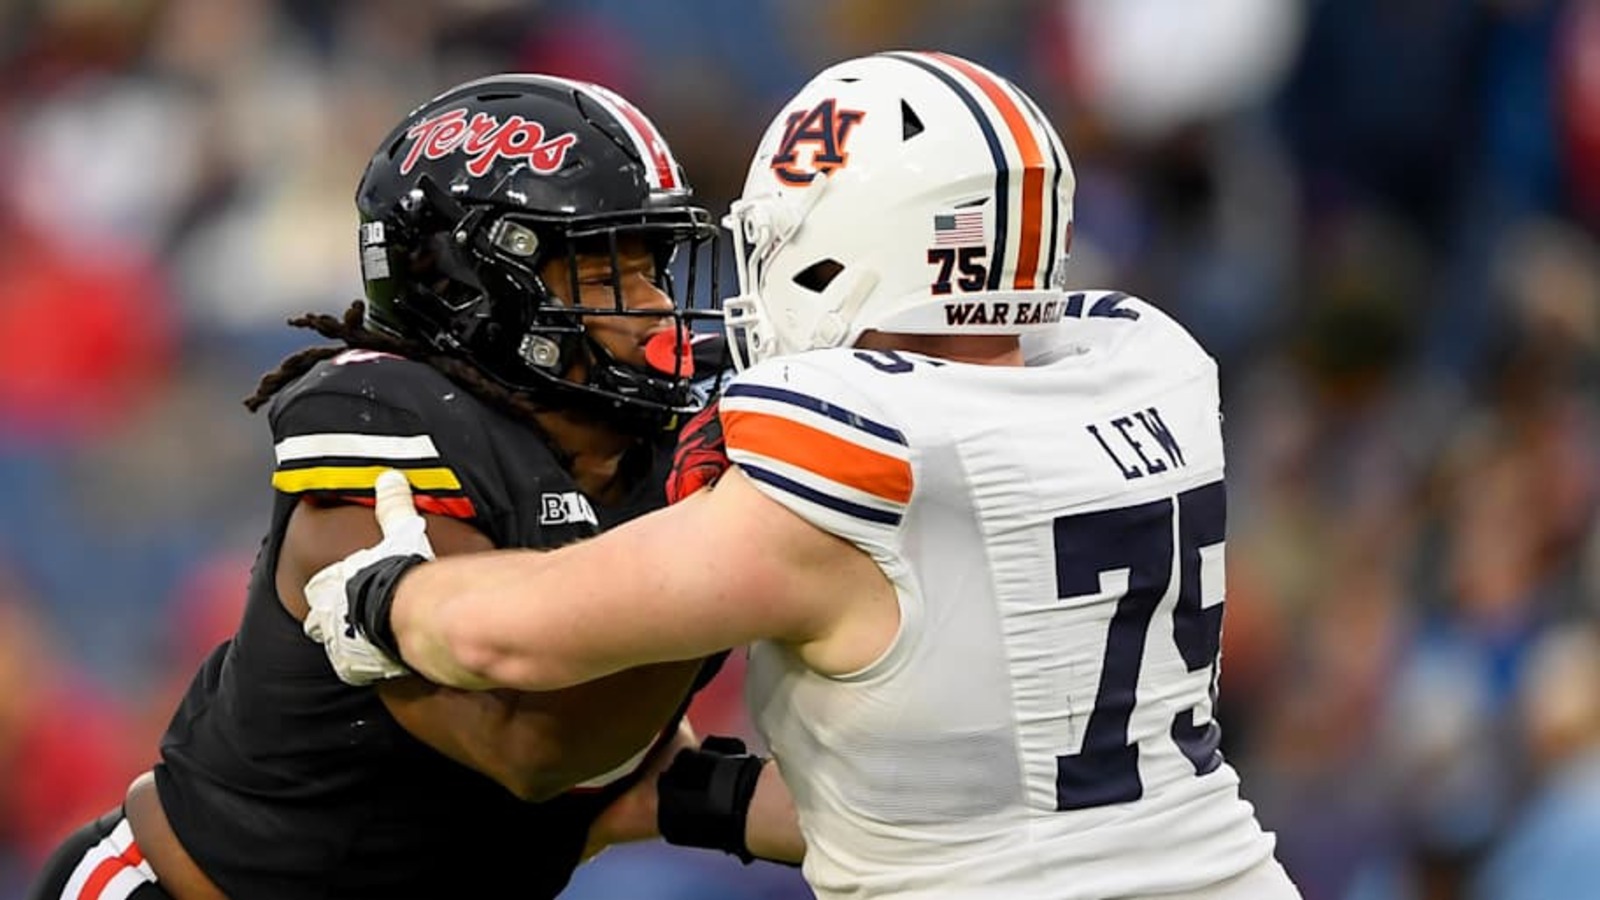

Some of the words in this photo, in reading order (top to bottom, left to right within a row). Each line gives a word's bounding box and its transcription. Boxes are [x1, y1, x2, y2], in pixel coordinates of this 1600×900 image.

[399, 108, 577, 177] Terps
[926, 245, 987, 295] 75
[944, 302, 1009, 325] WAR
[1086, 406, 1186, 480] LEW
[1053, 479, 1227, 812] 75
